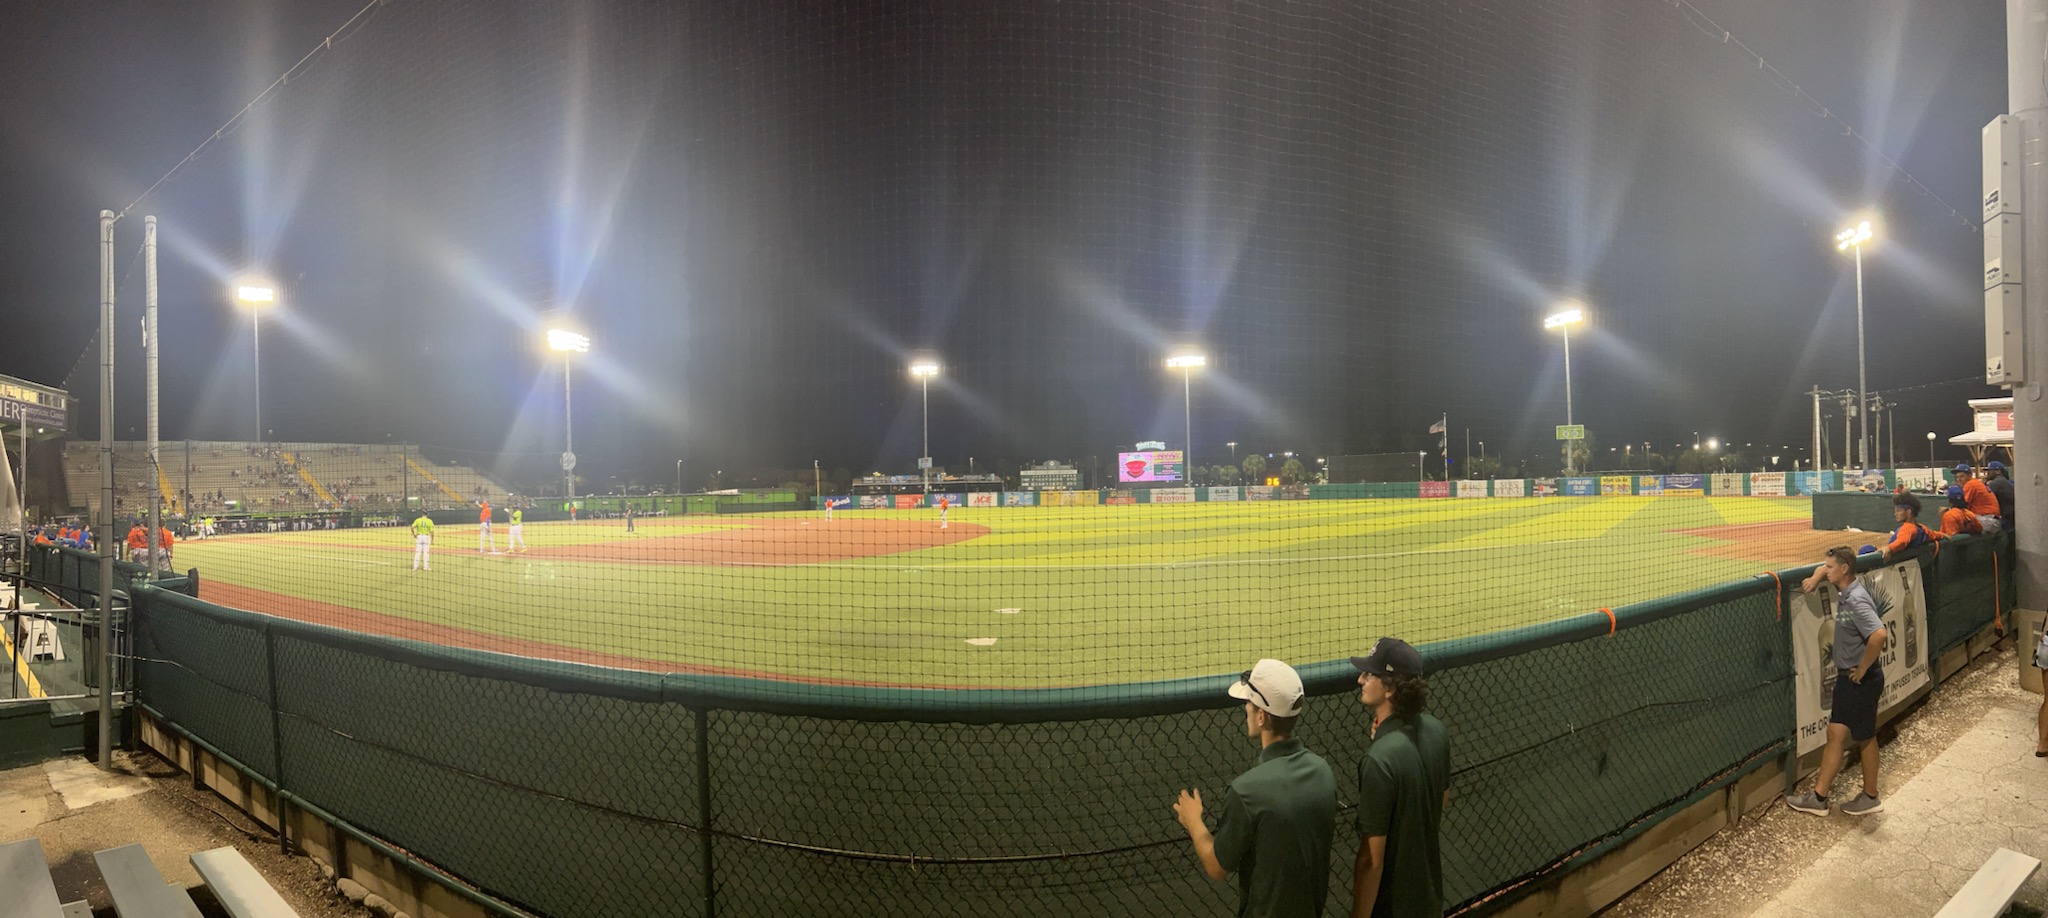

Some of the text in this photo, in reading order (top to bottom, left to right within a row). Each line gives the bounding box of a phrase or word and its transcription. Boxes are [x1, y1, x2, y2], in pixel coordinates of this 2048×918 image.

[974, 495, 993, 504] ACE
[1162, 495, 1187, 503] TOYOTA
[1800, 722, 1817, 739] THE
